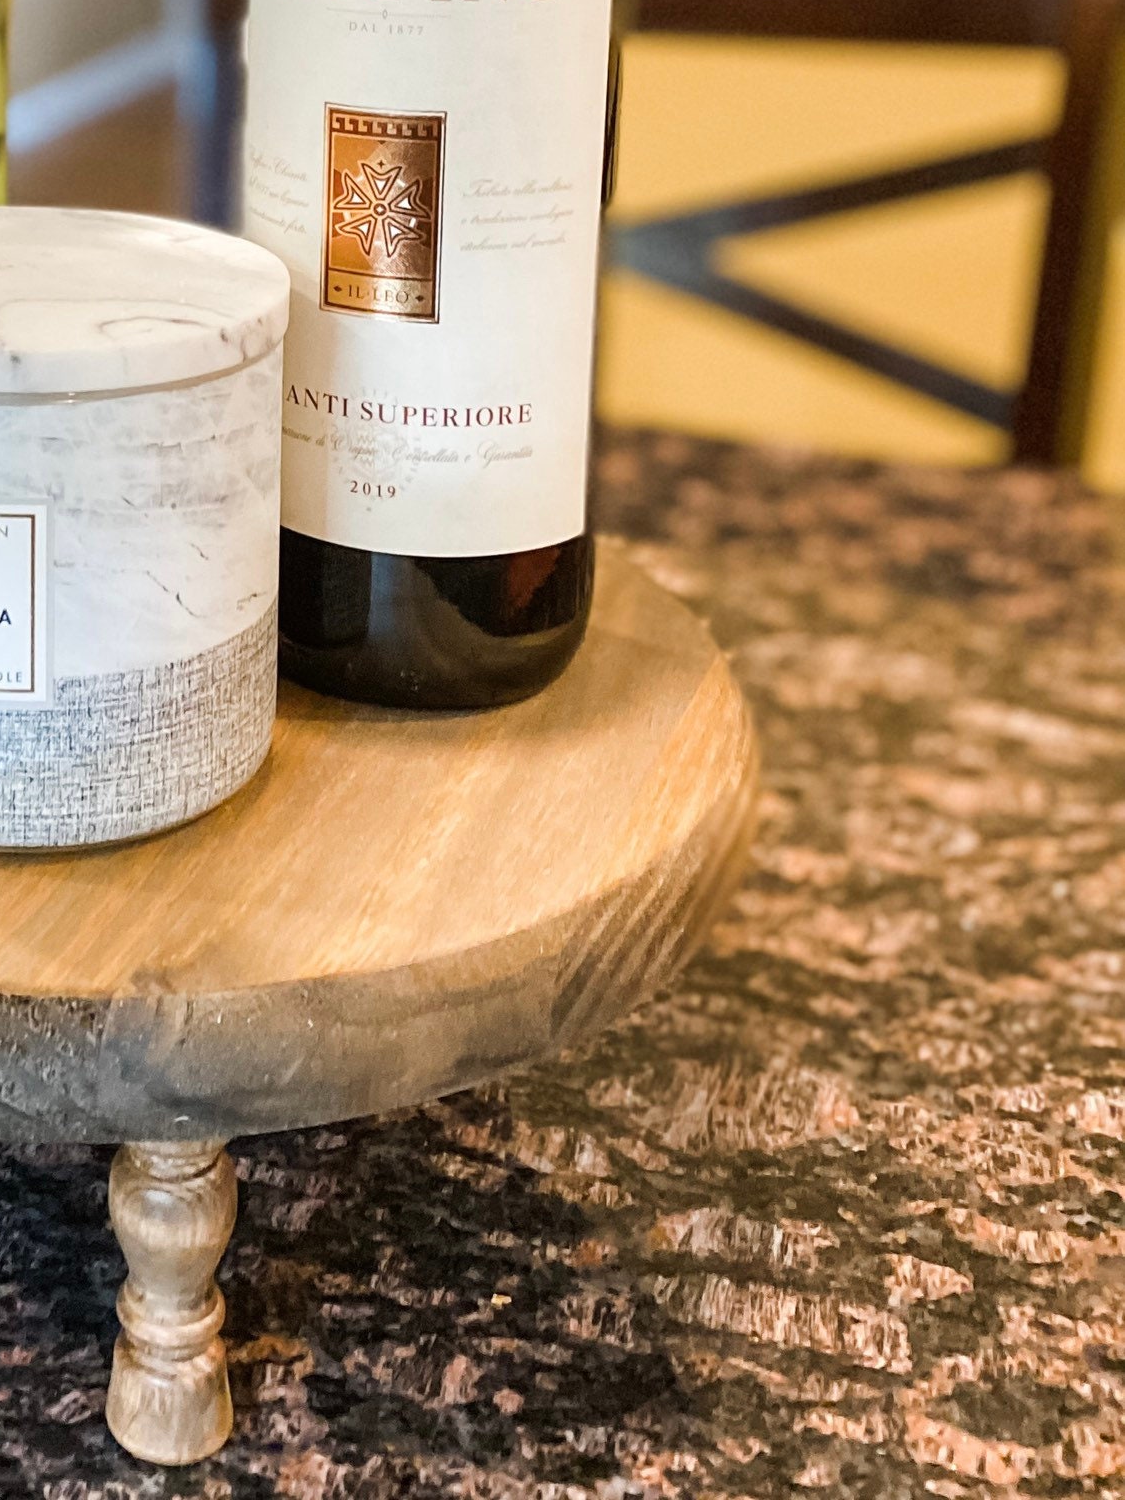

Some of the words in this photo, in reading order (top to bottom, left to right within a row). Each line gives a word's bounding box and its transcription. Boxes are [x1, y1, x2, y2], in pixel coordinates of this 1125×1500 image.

[349, 21, 378, 34] DAL
[388, 24, 424, 36] 1877
[285, 384, 350, 417] ANTI
[360, 401, 534, 428] SUPERIORE
[350, 480, 397, 498] 2019
